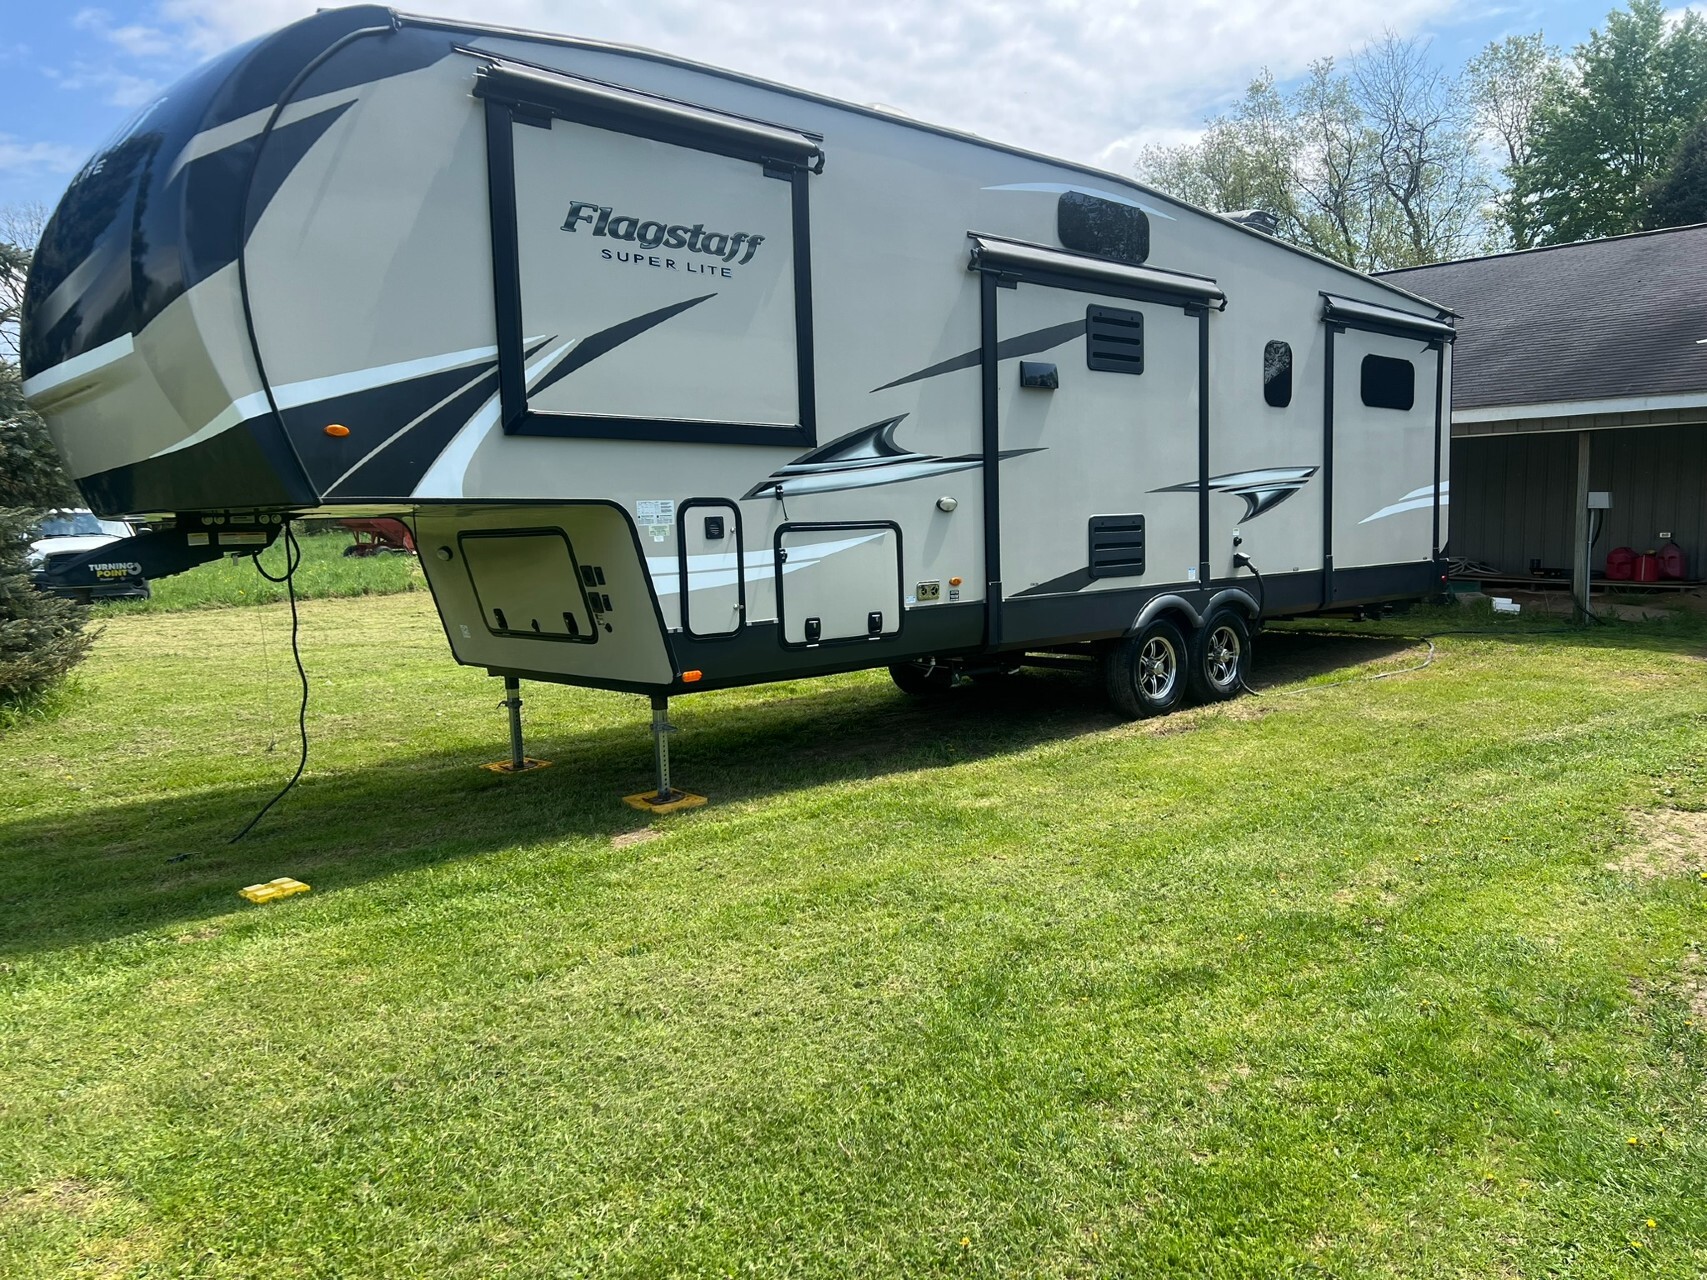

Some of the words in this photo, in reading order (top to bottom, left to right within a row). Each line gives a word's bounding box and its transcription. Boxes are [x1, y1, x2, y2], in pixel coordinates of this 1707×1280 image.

[559, 200, 766, 265] Flagstaff
[601, 249, 677, 270] SUPER
[687, 262, 733, 279] LITE
[88, 562, 134, 572] TURNING
[96, 569, 128, 578] POINT
